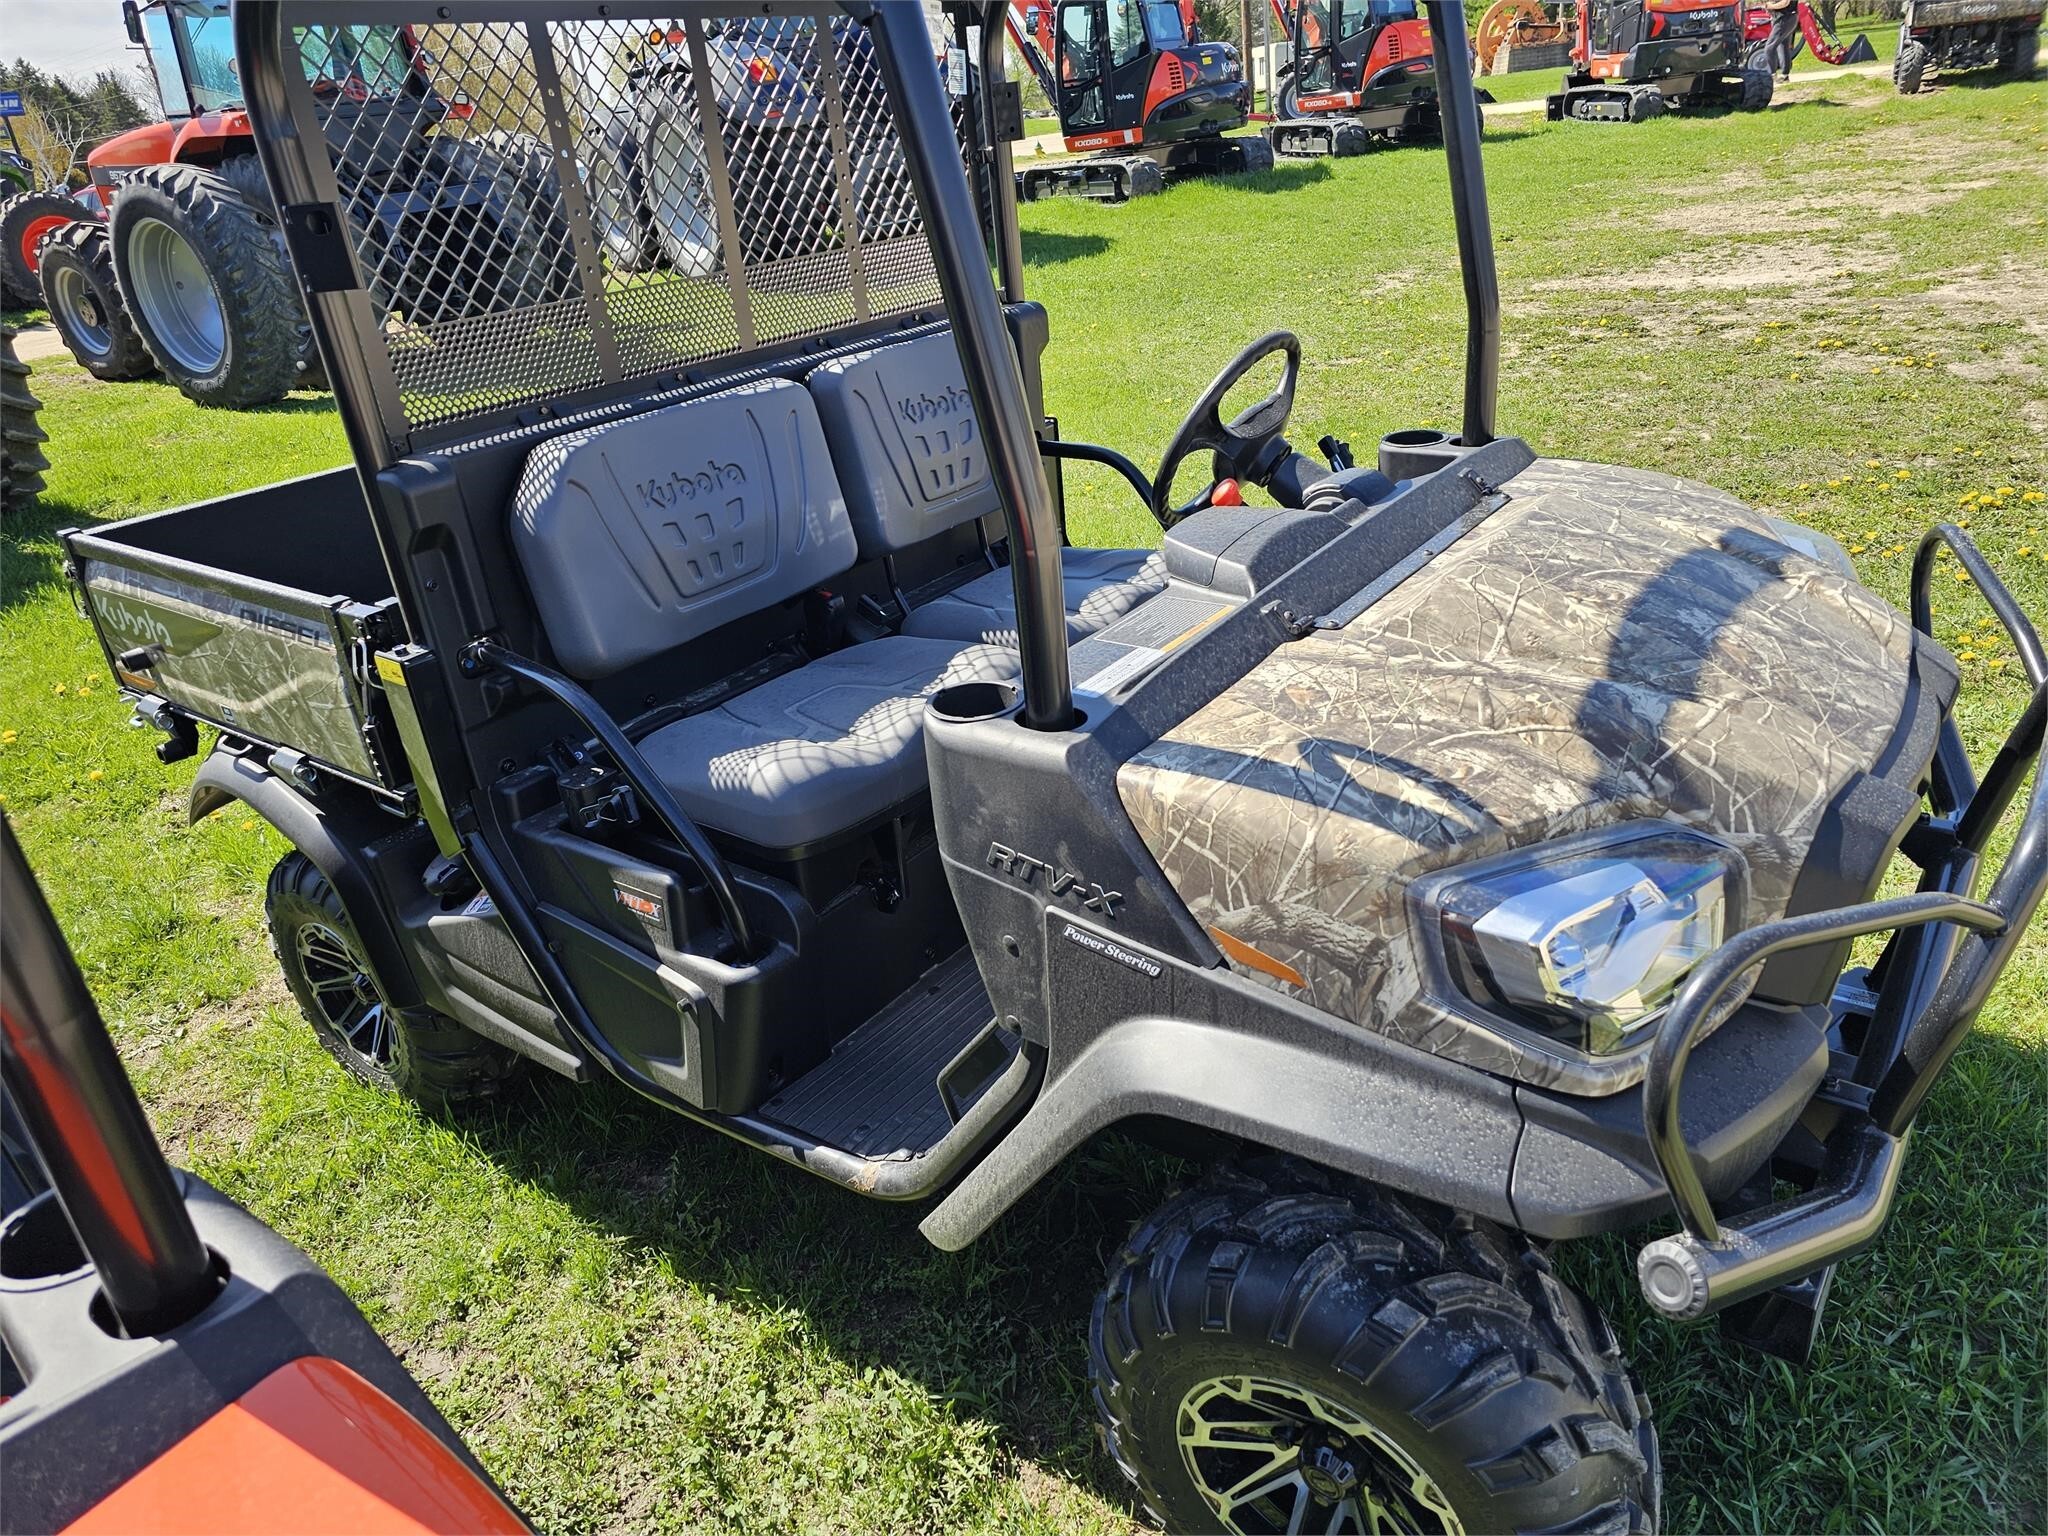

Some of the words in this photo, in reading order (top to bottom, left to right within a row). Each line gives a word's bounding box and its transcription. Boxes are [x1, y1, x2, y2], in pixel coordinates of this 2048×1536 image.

[1689, 9, 1719, 20] Kubota
[1962, 3, 1998, 14] Kubota
[1115, 93, 1135, 101] Kubota
[897, 385, 970, 425] Kubota
[636, 460, 746, 510] Kubota
[93, 592, 174, 649] Kubota
[240, 607, 330, 652] DIESEL
[986, 841, 1123, 917] RTV-X
[1064, 924, 1105, 951] Power
[1104, 943, 1161, 977] Steering
